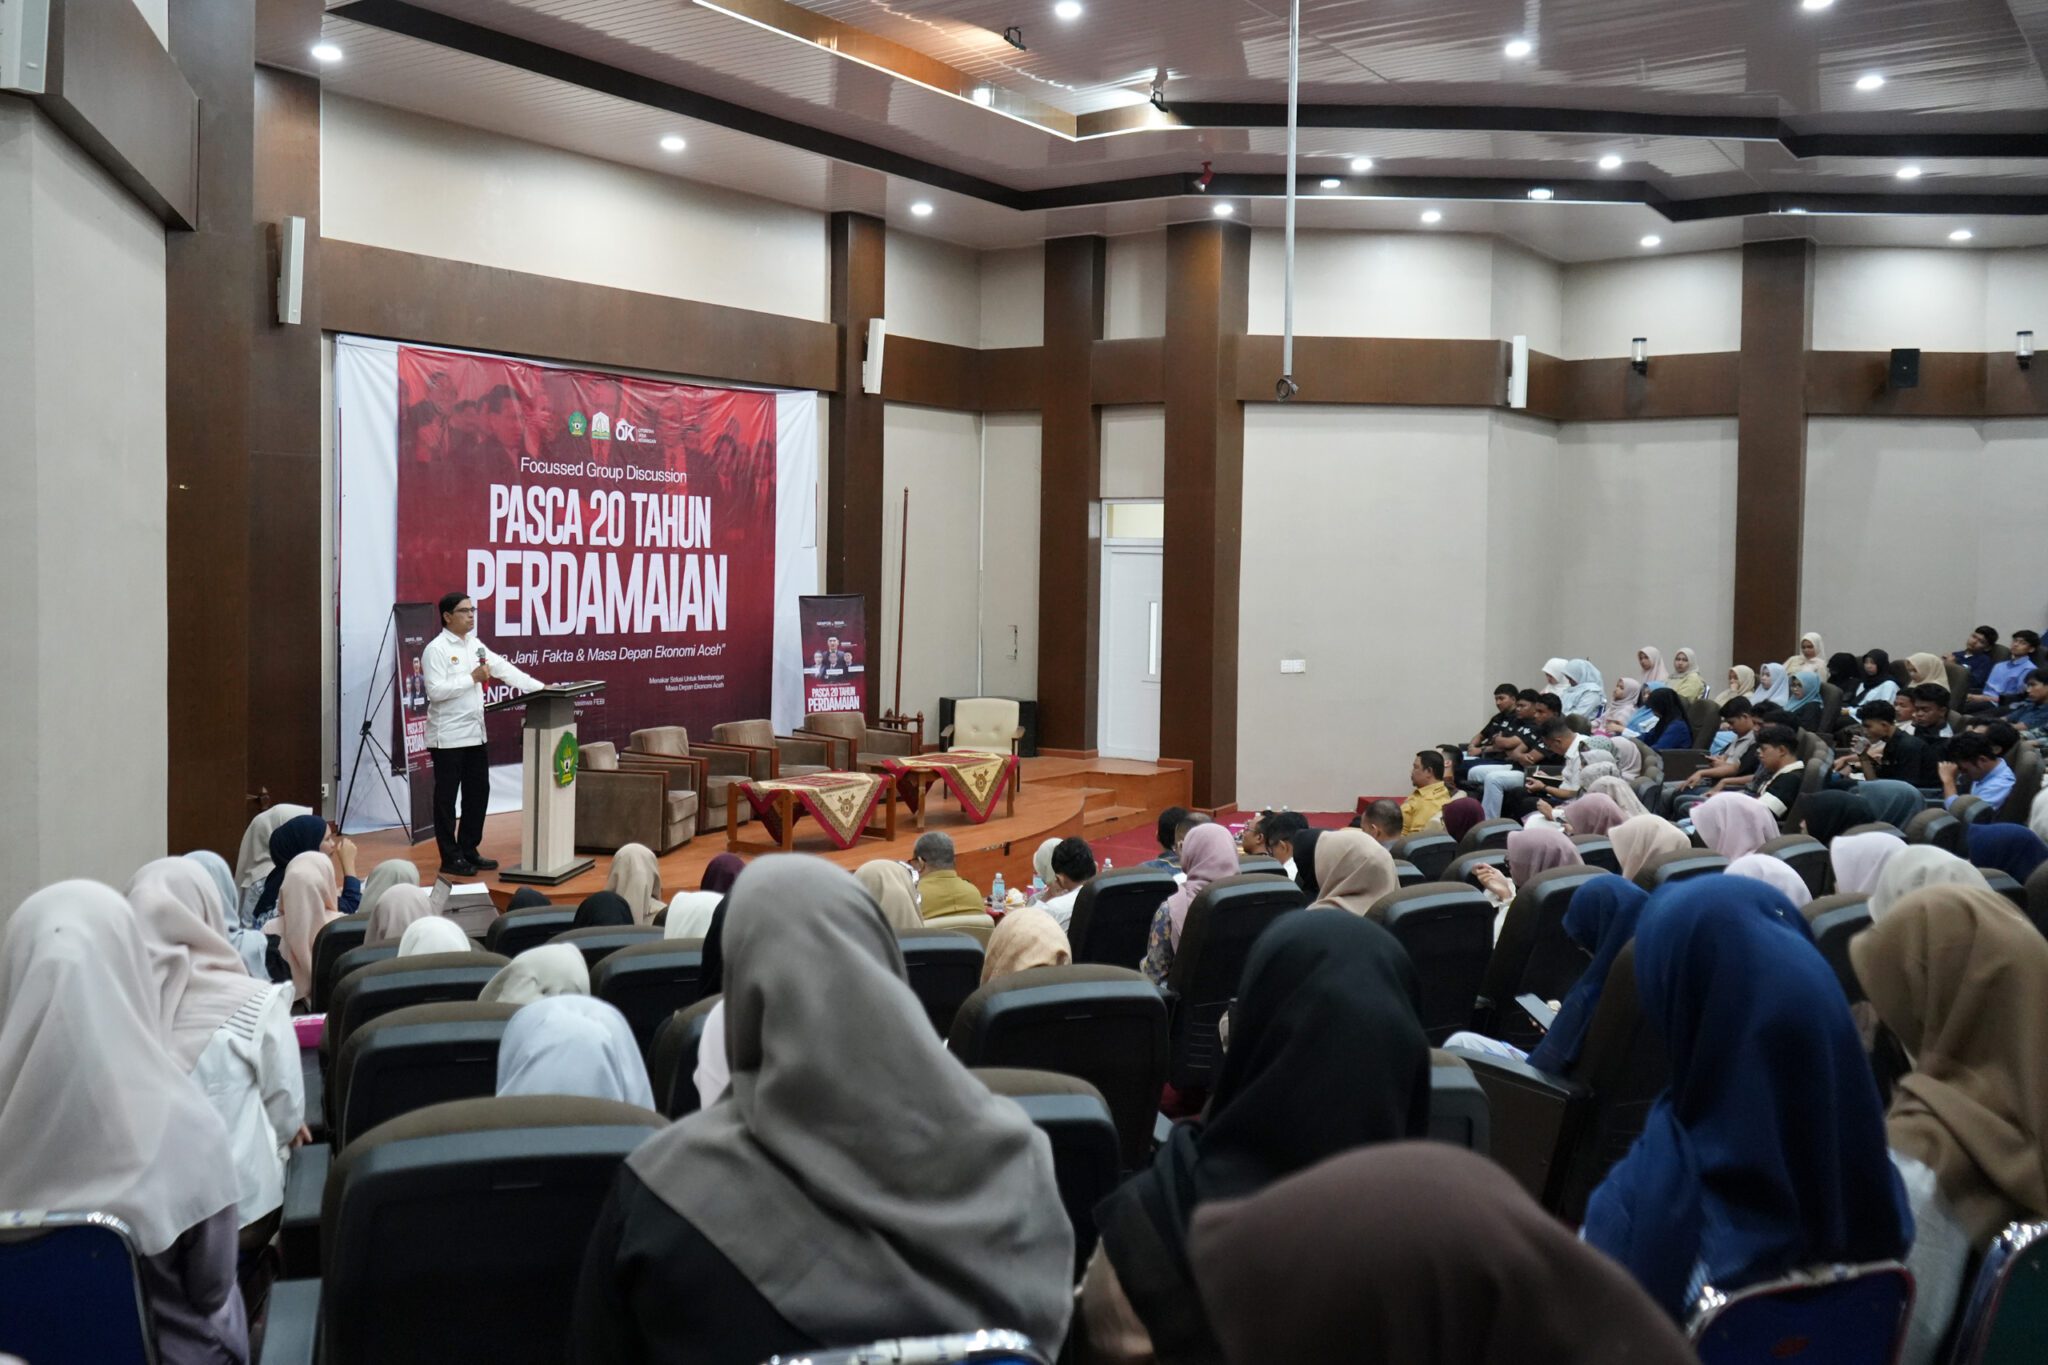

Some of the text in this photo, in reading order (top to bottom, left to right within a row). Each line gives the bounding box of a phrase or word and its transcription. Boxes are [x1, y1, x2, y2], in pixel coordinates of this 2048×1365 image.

[520, 456, 687, 483] Focussed Group Discussion
[489, 483, 711, 548] PASCA 20 TAHUN
[465, 549, 728, 637] PERDAMAIAN
[511, 650, 539, 667] Janji,
[542, 649, 574, 663] Fakta
[576, 648, 585, 662] &
[587, 647, 617, 661] Masa
[619, 647, 653, 662] Depan
[655, 644, 697, 658] Ekonomi
[679, 684, 693, 692] Depan
[697, 674, 724, 683] Membangun
[812, 686, 856, 697] PASCA 20 TAHUN
[808, 696, 860, 712] PERDAMAIAN
